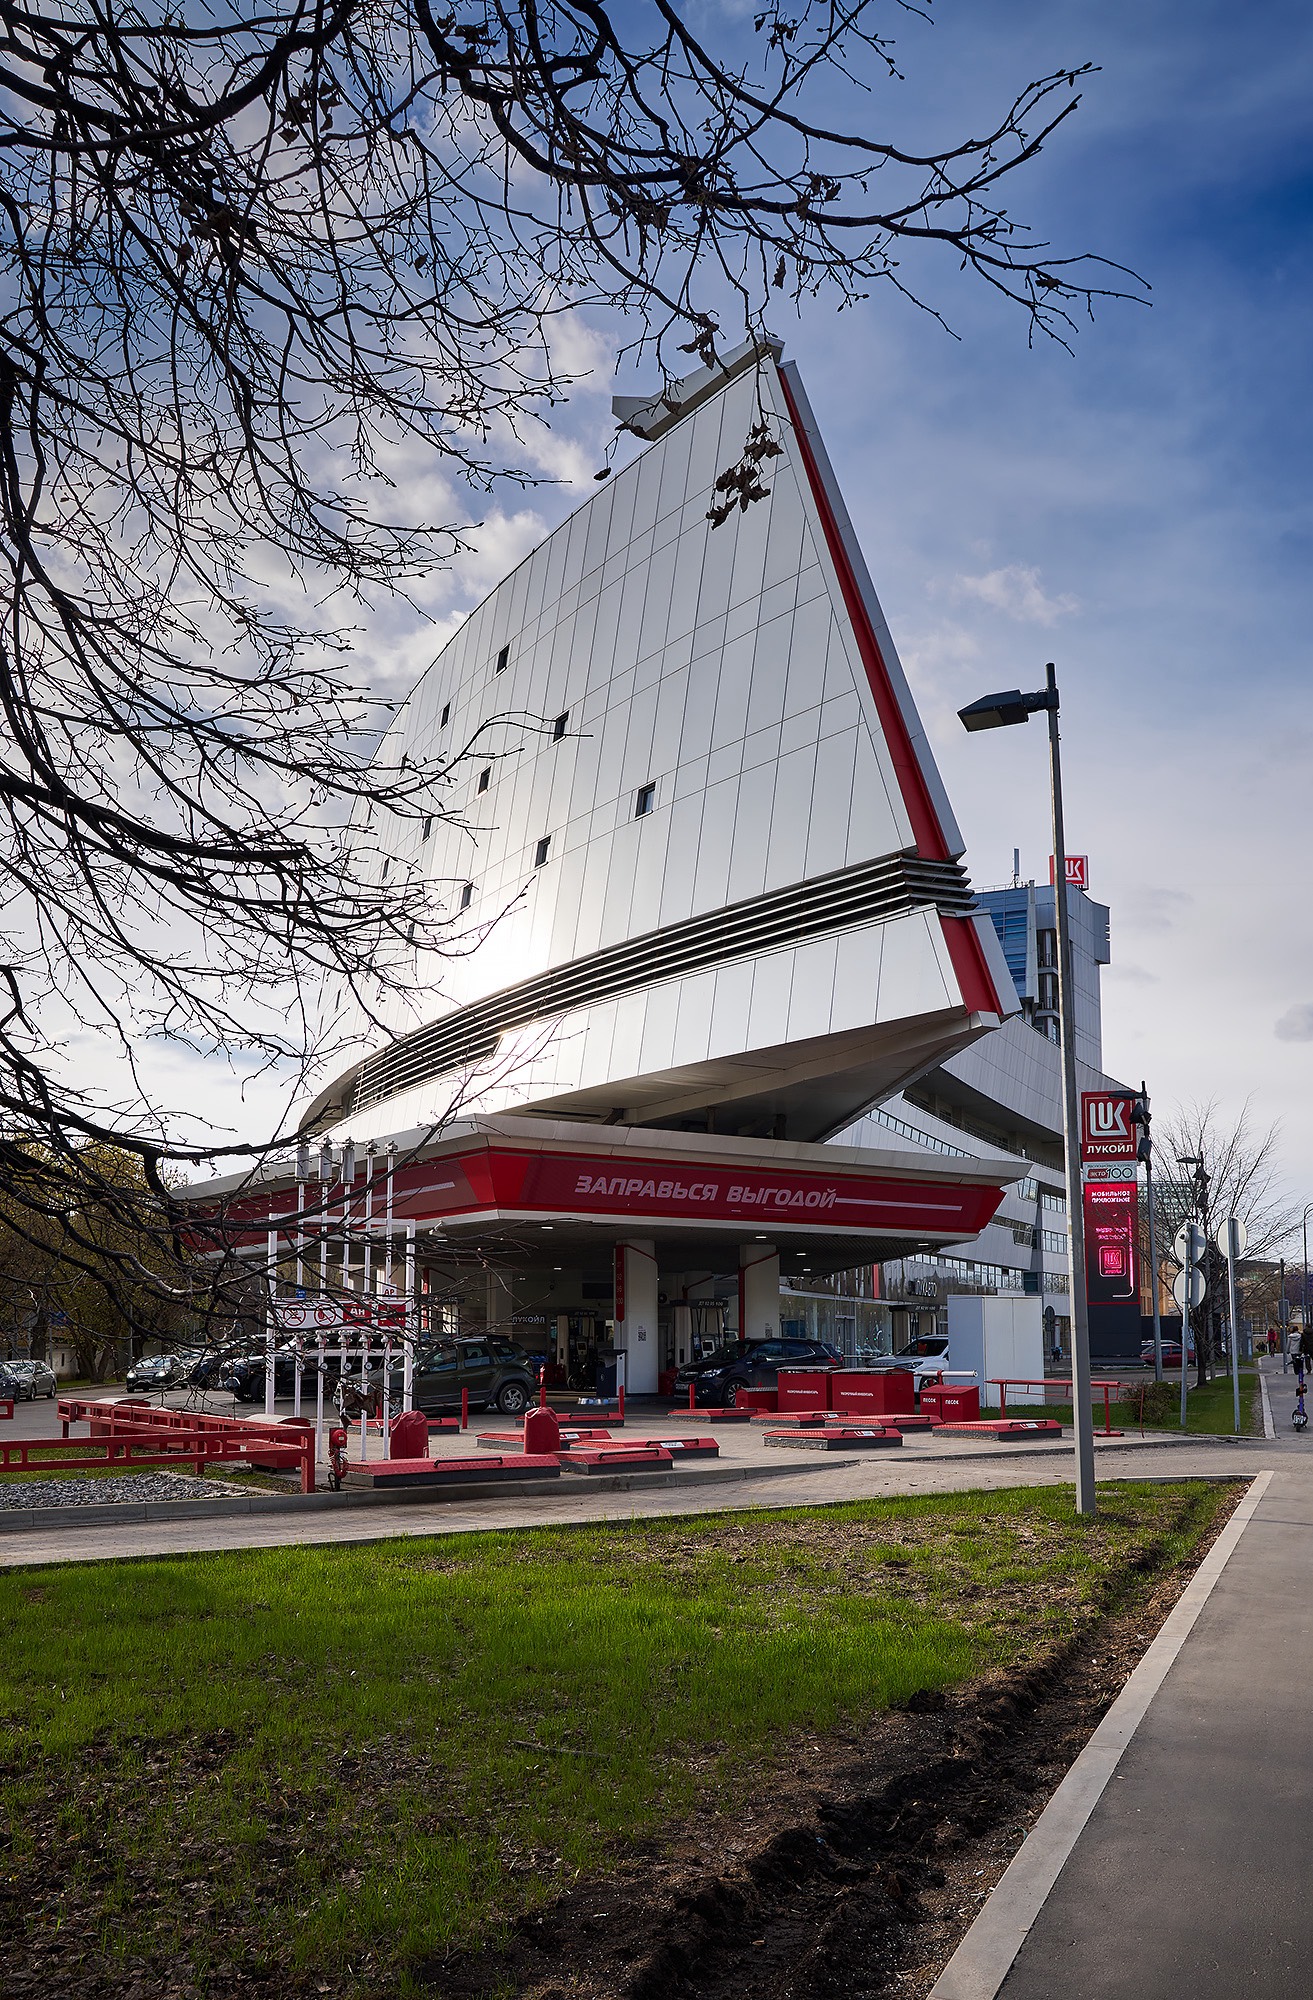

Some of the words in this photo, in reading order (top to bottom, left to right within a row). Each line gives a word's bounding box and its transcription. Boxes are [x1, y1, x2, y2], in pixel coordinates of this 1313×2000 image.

[1089, 1102, 1128, 1136] LUK
[1086, 1143, 1133, 1154] ЛУКОЙЛ
[1107, 1168, 1133, 1178] 100
[574, 1175, 719, 1201] ЗАПРАВЬСЯ
[726, 1186, 837, 1208] ВЫГОДОЙ
[512, 1315, 545, 1323] ЛУКОЙЛ
